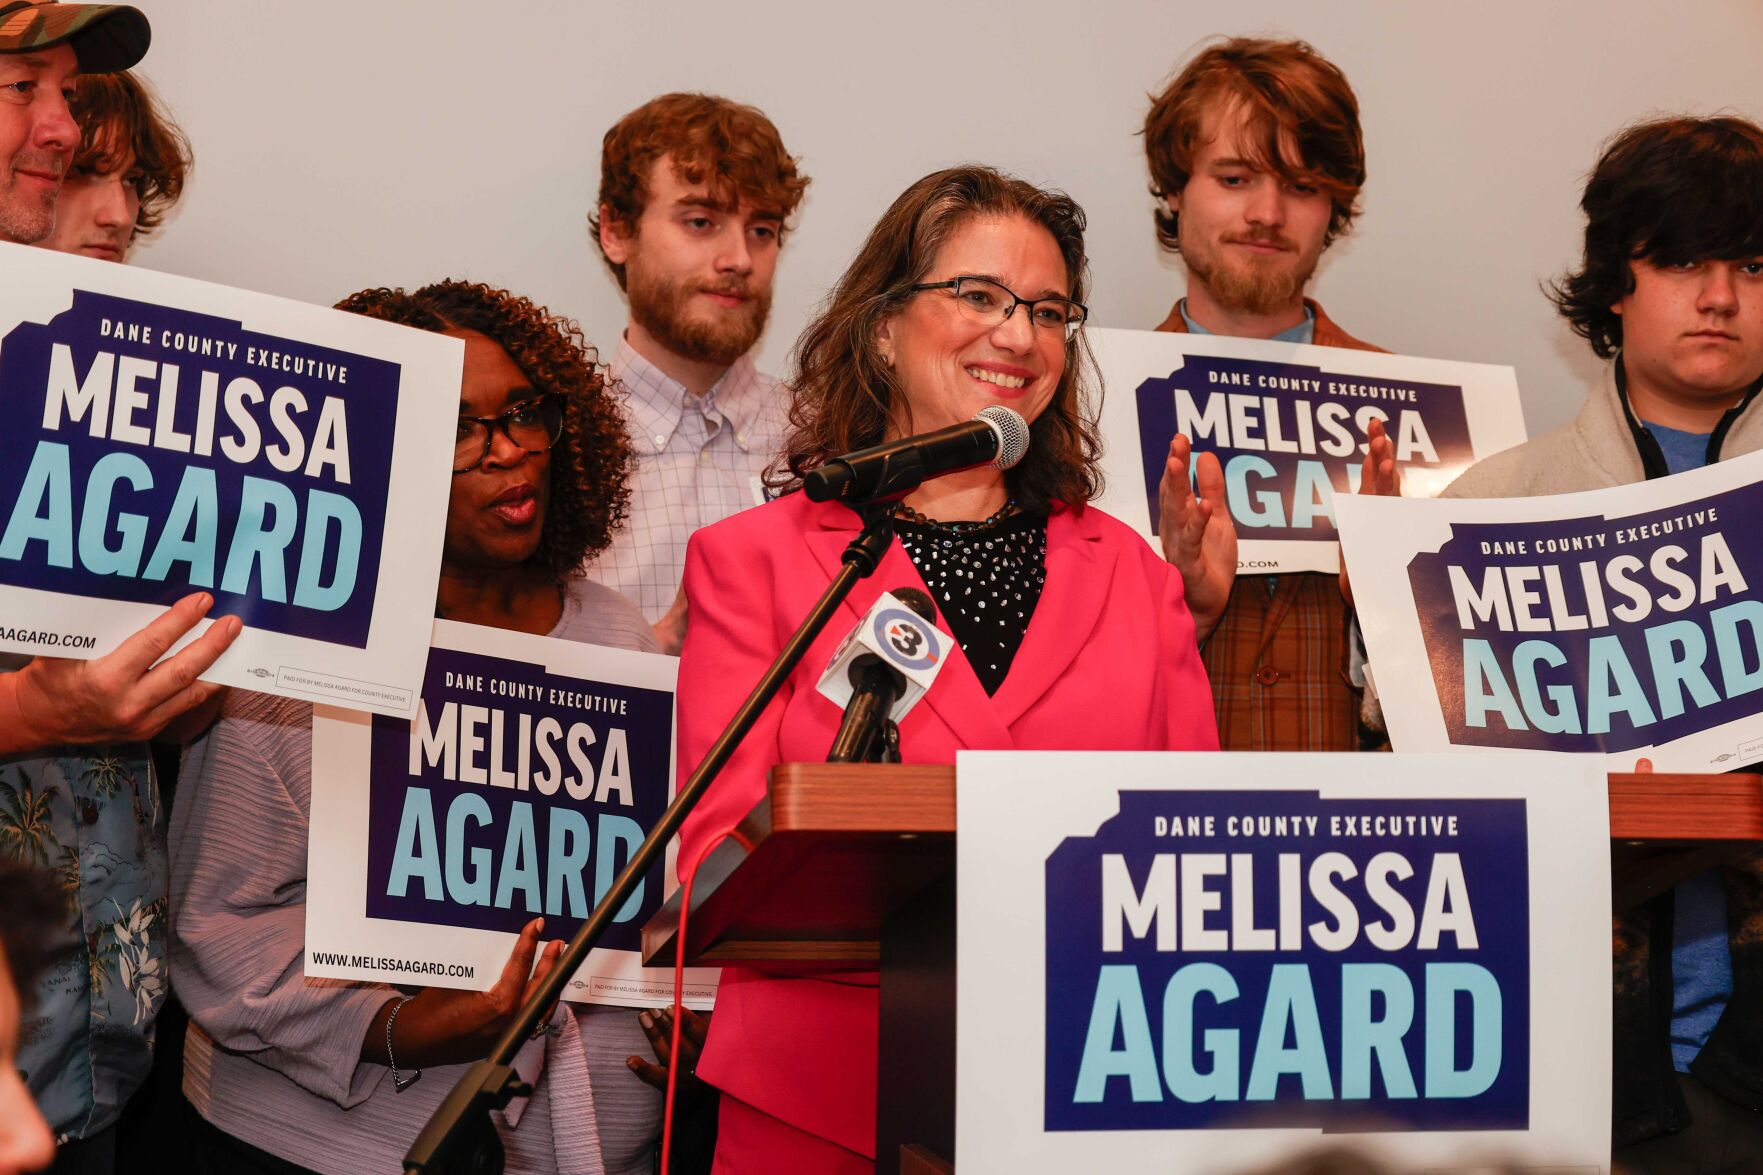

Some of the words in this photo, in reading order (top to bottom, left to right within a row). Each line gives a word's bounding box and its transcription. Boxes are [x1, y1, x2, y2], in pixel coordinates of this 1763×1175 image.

[101, 318, 152, 345] DANE
[162, 330, 238, 360] COUNTY
[247, 346, 348, 384] EXECUTIVE
[1208, 370, 1251, 386] DANE
[1259, 375, 1321, 393] COUNTY
[1328, 382, 1417, 402] EXECUTIVE
[43, 342, 351, 485] MELISSA
[0, 440, 363, 612] AGARD
[1480, 540, 1528, 555] DANE
[1535, 533, 1606, 554] COUNTY
[1615, 507, 1718, 545] EXECUTIVE
[1448, 531, 1749, 632] MELISSA
[891, 623, 923, 657] 3
[1462, 600, 1763, 735] AGARD
[314, 680, 334, 689] MELISSA
[334, 684, 351, 692] AGARD
[362, 689, 382, 697] COUNTY
[381, 692, 406, 702] EXECUTIVE
[445, 671, 483, 692] DANE
[490, 678, 544, 702] COUNTY
[549, 688, 627, 715] EXECUTIVE
[409, 697, 634, 807] MELISSA
[386, 786, 646, 923] AGARD
[1154, 815, 1216, 837] DANE
[1227, 815, 1319, 837] COUNTY
[1330, 815, 1458, 837] EXECUTIVE
[1102, 851, 1480, 952] MELISSA
[313, 952, 475, 978] WWW.MELISSAAGARD.COM
[1073, 962, 1503, 1103] AGARD
